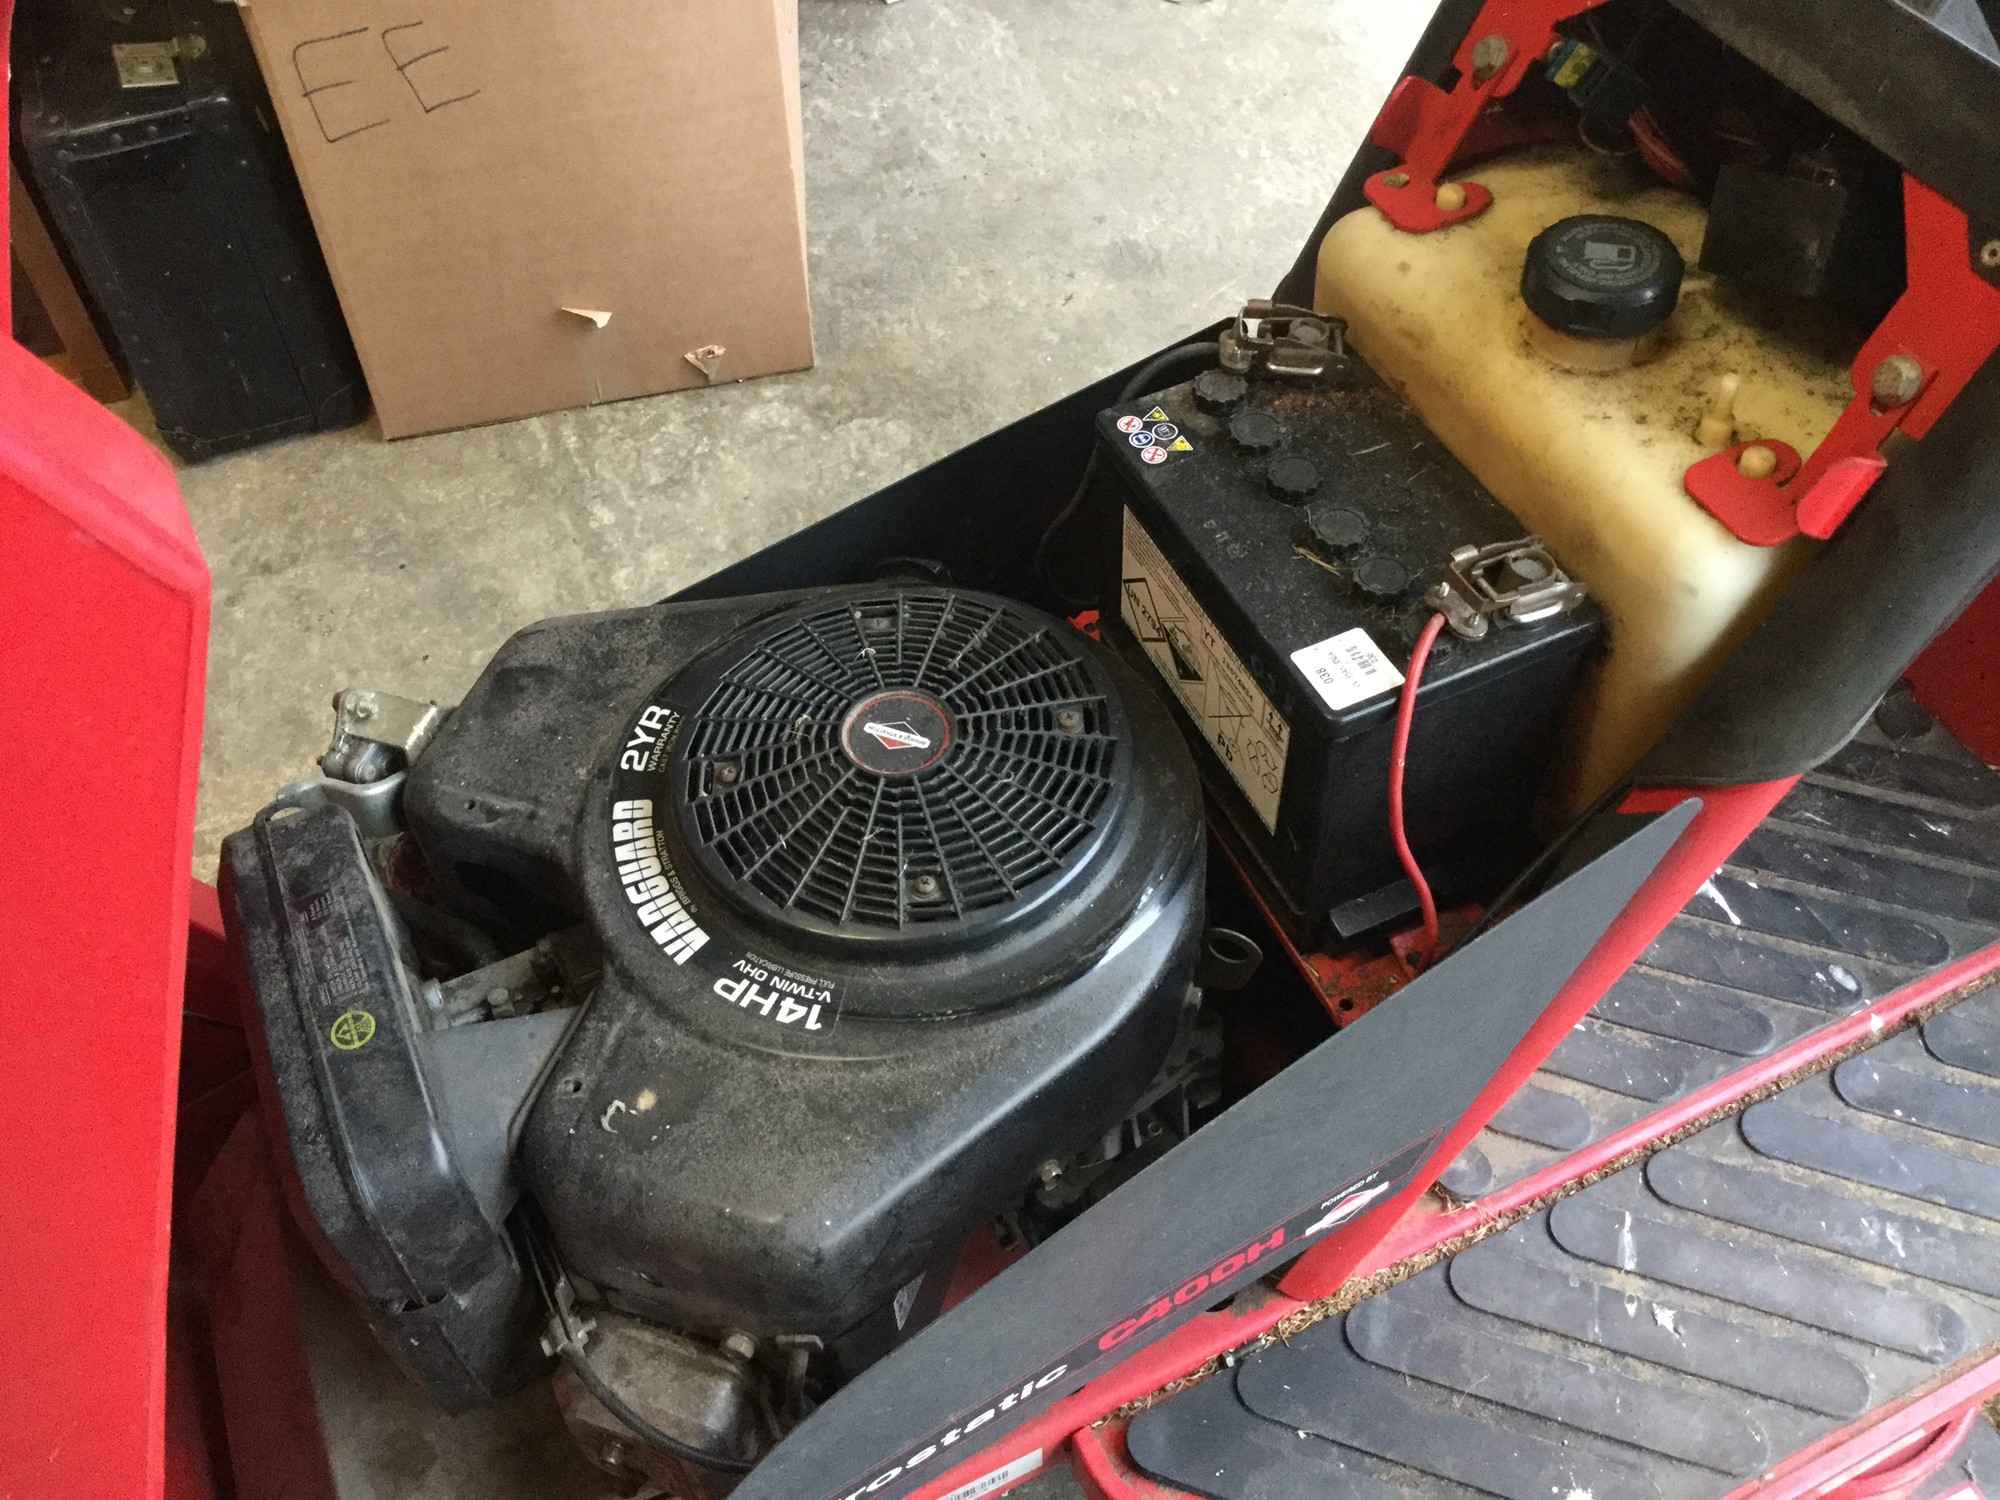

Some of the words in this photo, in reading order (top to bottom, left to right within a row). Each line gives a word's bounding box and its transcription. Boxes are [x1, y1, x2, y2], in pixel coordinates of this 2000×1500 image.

[1316, 667, 1335, 684] 038
[620, 705, 671, 771] 2YR
[647, 711, 680, 771] WARRANTY
[1218, 733, 1232, 762] Pb
[659, 753, 668, 773] CAST
[656, 830, 673, 870] STRATTON
[612, 799, 710, 966] VANGUARD
[670, 876, 691, 905] BRIGGS
[732, 959, 768, 981] OHV
[745, 951, 785, 973] LUBRICATION
[769, 976, 831, 1003] V-TWIN
[783, 968, 819, 986] PRESSURE
[820, 978, 836, 989] FULL
[713, 978, 822, 1030] 14HP
[1098, 1228, 1284, 1350] C400H
[837, 1364, 1067, 1500] rostatic
